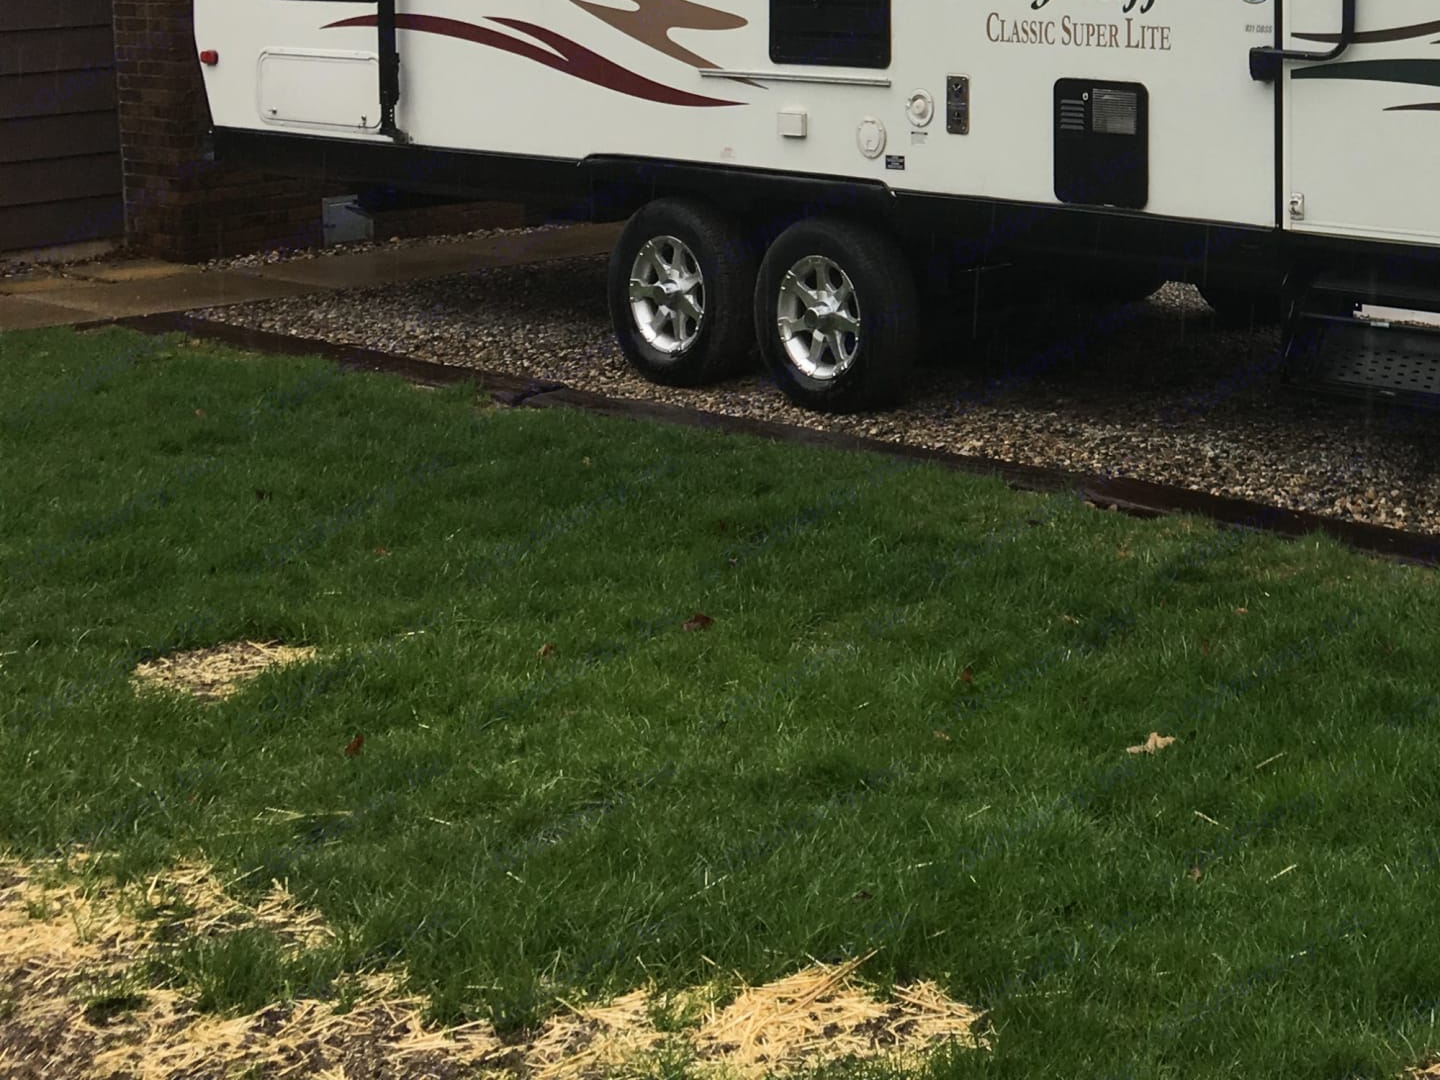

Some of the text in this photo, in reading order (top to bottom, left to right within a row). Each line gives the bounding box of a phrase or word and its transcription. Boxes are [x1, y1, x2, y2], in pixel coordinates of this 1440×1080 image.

[986, 12, 1172, 51] CLASSIC SUPER LITE
